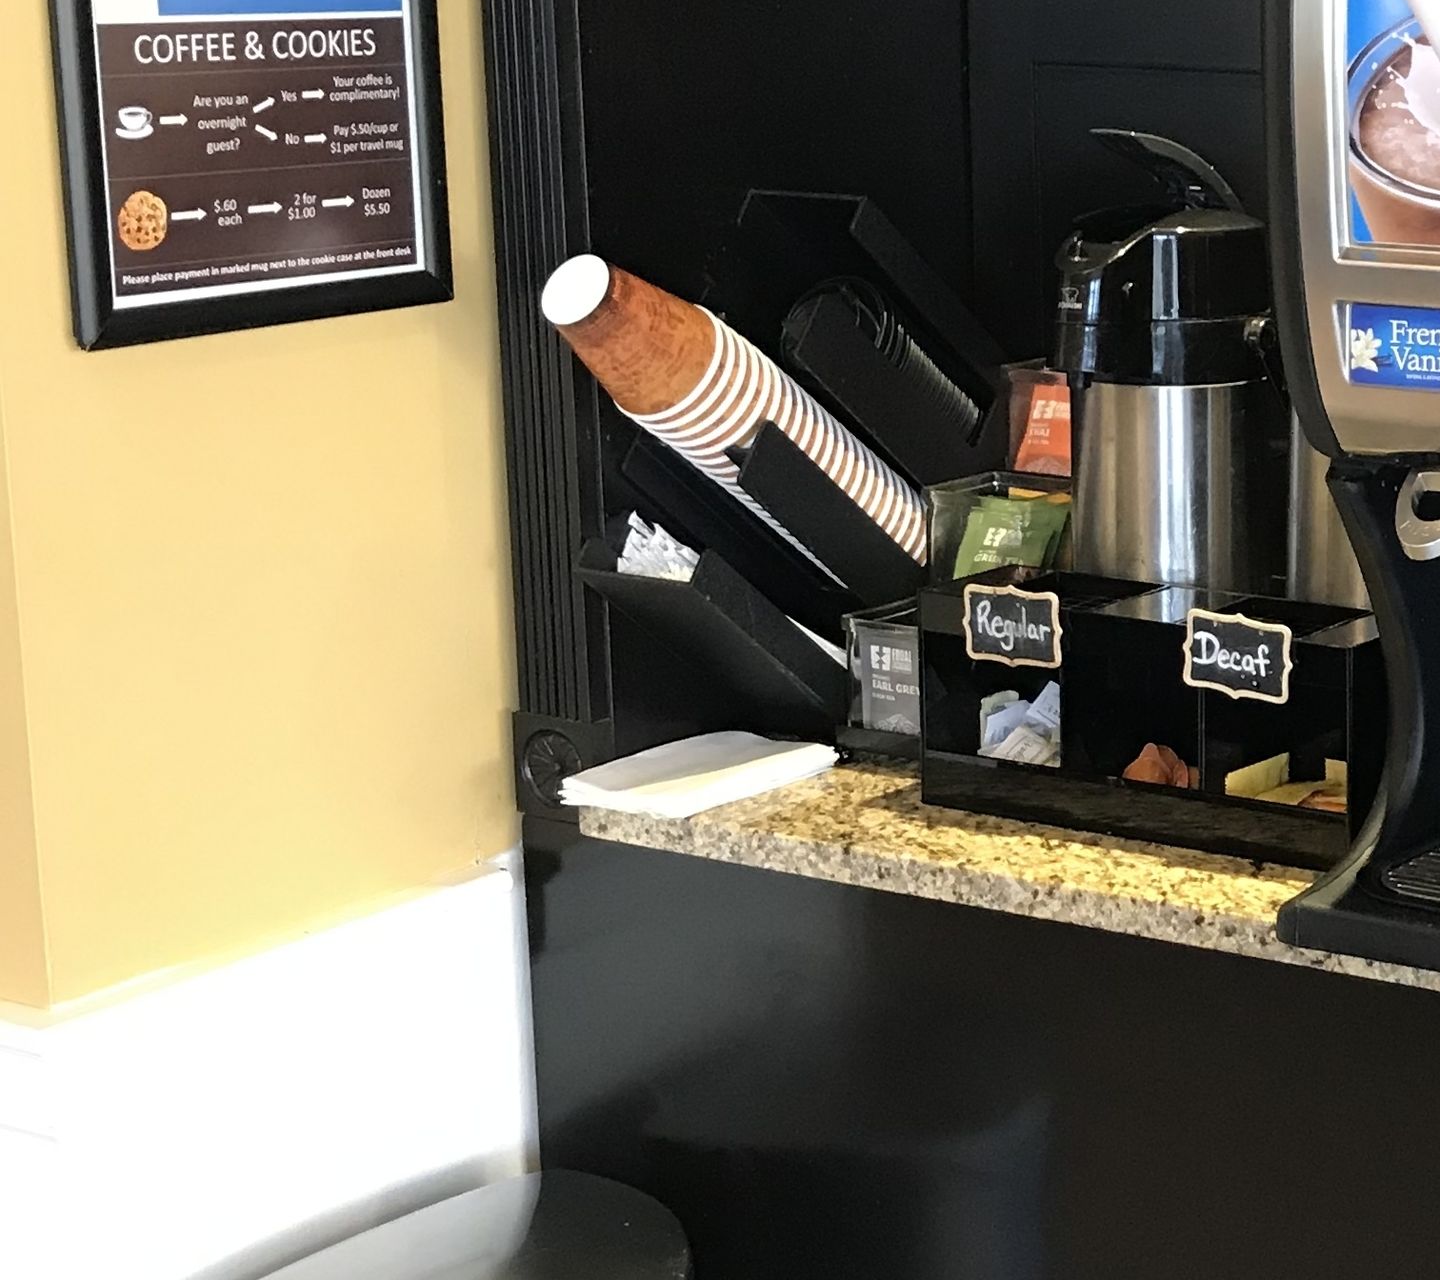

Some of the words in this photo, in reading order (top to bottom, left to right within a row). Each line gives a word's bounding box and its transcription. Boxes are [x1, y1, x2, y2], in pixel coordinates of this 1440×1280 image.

[134, 32, 237, 64] COFFEE
[244, 30, 266, 61] &
[272, 28, 377, 59] COOKIES
[333, 75, 354, 88] Your
[356, 73, 384, 87] coffee
[385, 73, 393, 86] is
[193, 95, 213, 108] Are
[214, 95, 234, 109] you
[235, 94, 249, 106] an
[280, 89, 298, 102] Yes
[329, 86, 400, 103] complimentary!
[197, 115, 248, 131] overnight
[333, 124, 350, 138] Pay
[350, 122, 389, 137] $.50/cup
[389, 122, 400, 133] or
[206, 137, 241, 155] guest?
[284, 132, 300, 145] No
[330, 141, 342, 154] $1
[343, 141, 358, 155] per
[359, 138, 385, 152] travel
[385, 139, 404, 152] mug
[293, 193, 301, 206] 2
[302, 192, 318, 205] for
[362, 187, 391, 200] Dozen
[213, 198, 238, 214] $.60
[287, 206, 317, 221] $1.00
[364, 202, 391, 217] $5.50
[217, 212, 243, 227] each
[122, 274, 151, 285] Please
[151, 271, 174, 284] place
[174, 267, 211, 282] payment
[211, 266, 220, 276] in
[220, 262, 250, 275] marked
[251, 261, 269, 272] mug
[269, 258, 287, 269] next
[287, 257, 297, 268] to
[297, 255, 311, 267] the
[311, 253, 336, 266] cookie
[336, 251, 353, 263] case
[353, 250, 362, 261] at
[363, 248, 376, 260] the
[976, 599, 1051, 652] Regular
[1192, 630, 1271, 678] Decaf
[872, 679, 894, 692] EARL
